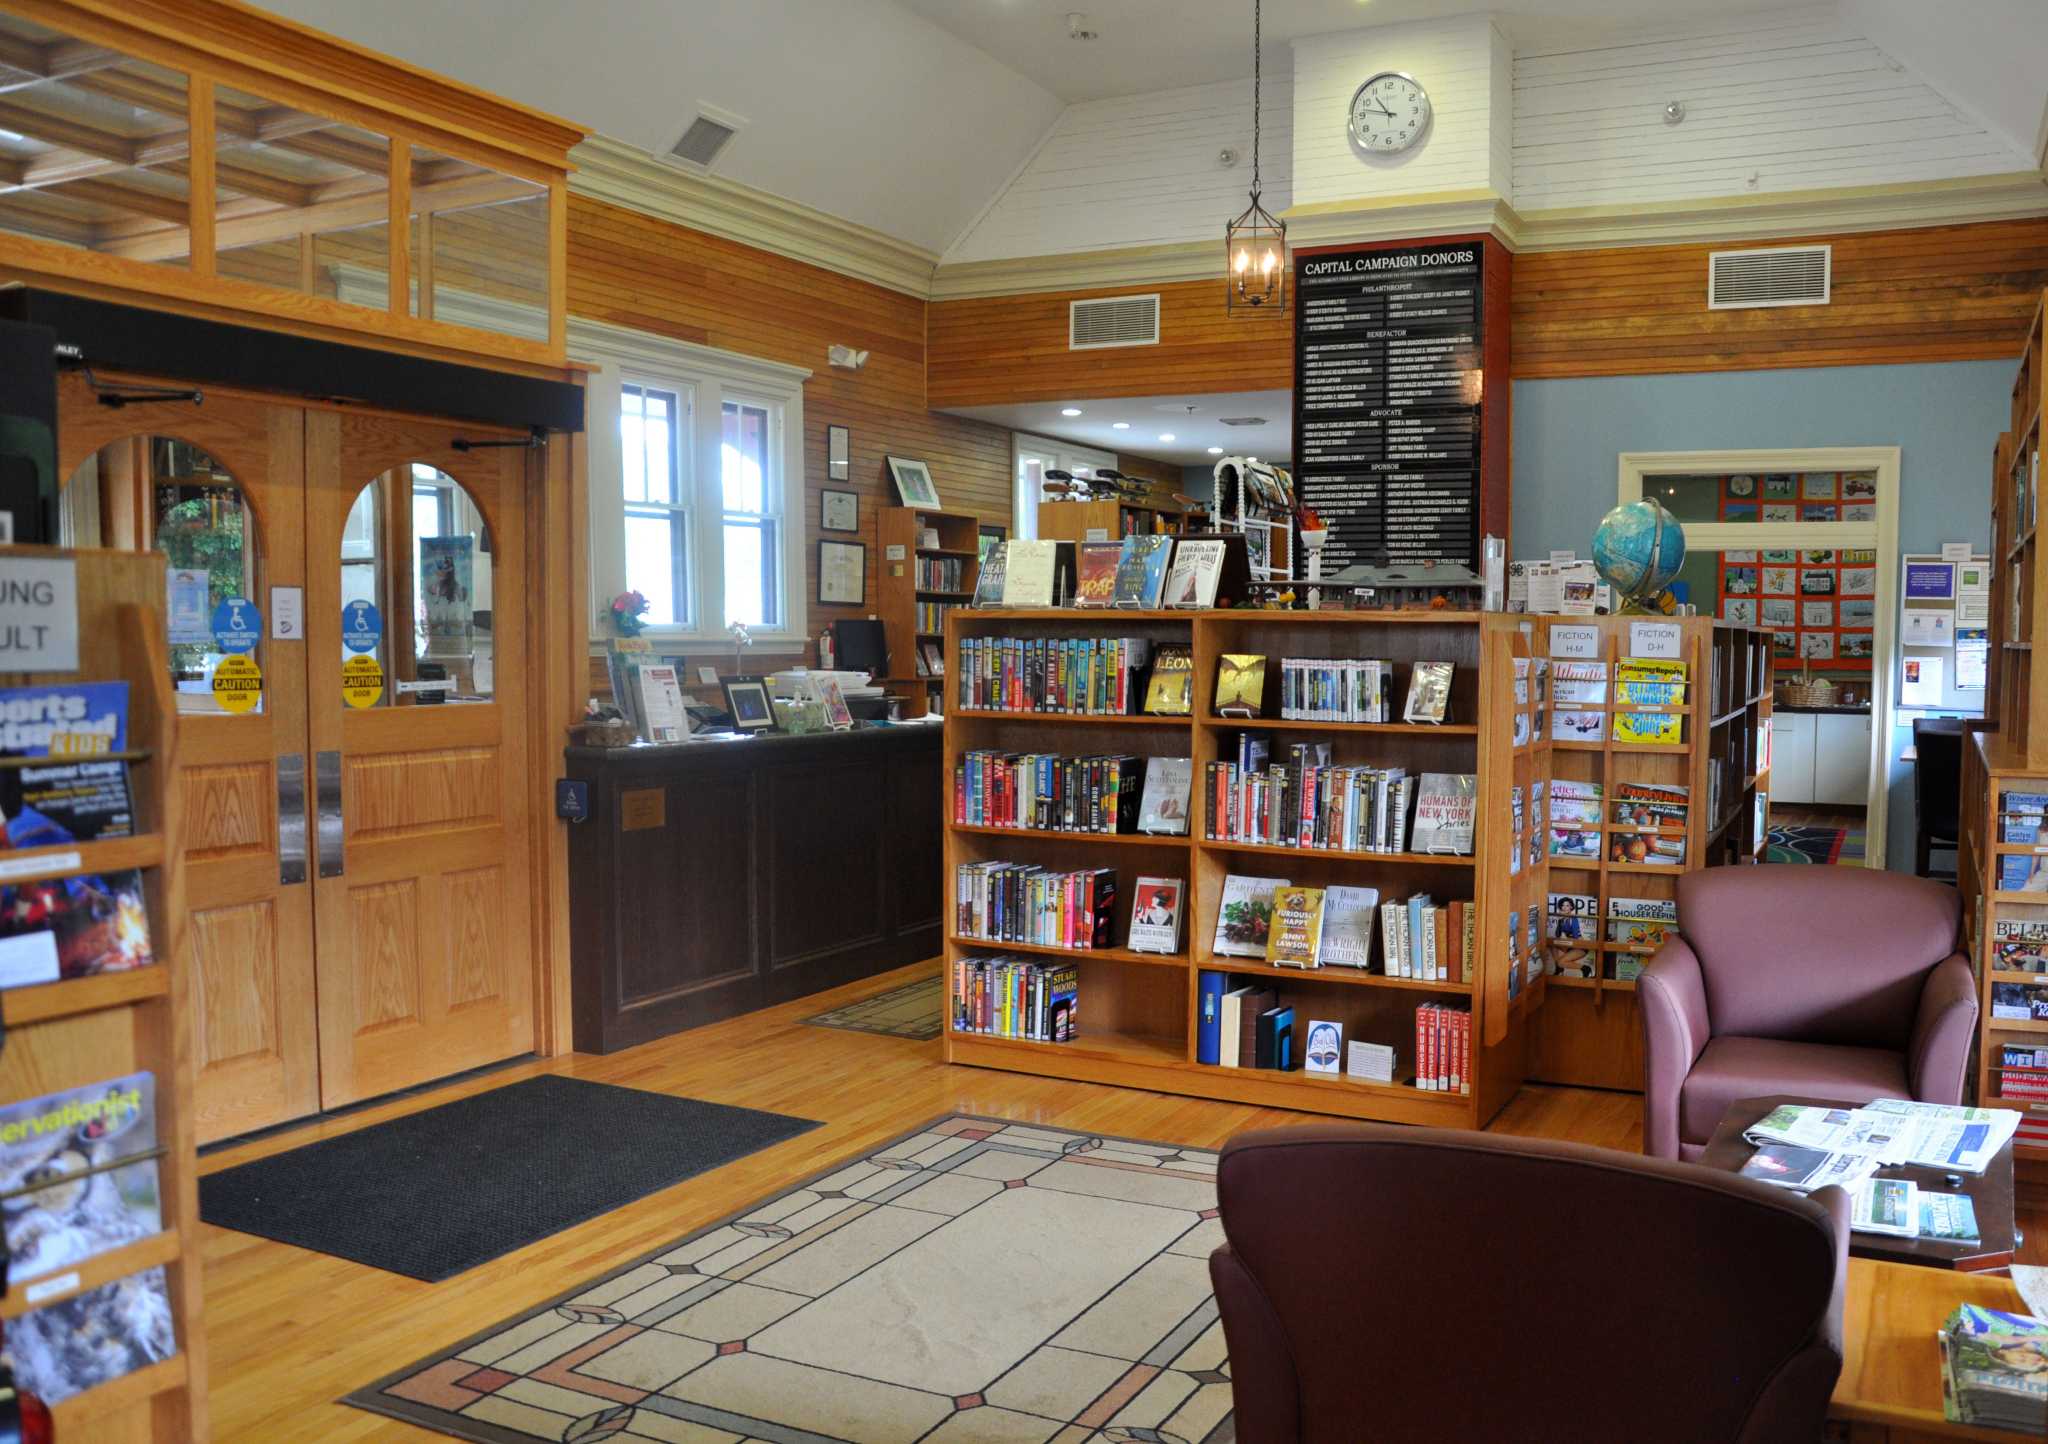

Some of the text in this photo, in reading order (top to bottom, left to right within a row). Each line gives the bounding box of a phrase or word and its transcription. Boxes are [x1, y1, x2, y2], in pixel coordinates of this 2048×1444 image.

[1305, 250, 1474, 275] CAPITAL CAMPAIGN DONORS
[1362, 283, 1413, 293] PHILANTHROPIST
[1366, 330, 1407, 338] BENEFACTOR
[1370, 409, 1403, 417] ADVOCATE
[1370, 463, 1400, 471] SPONSOR
[984, 563, 1007, 574] HEAT
[1557, 632, 1593, 640] FICTION
[1638, 630, 1675, 638] FICTION
[1648, 643, 1664, 651] D-H
[214, 678, 260, 690] CAUTION
[343, 676, 381, 688] CAUTION
[53, 734, 110, 753] KIDS
[1552, 784, 1577, 794] etter
[1421, 796, 1473, 806] HUMANS OF
[1419, 808, 1472, 820] NEW YORK
[1548, 897, 1596, 916] HPE
[1637, 903, 1664, 912] GOOD
[1278, 910, 1316, 919] FURIOUSLY
[1426, 912, 1434, 924] THE
[1618, 910, 1676, 920] HOUSEKEEPIN
[1283, 918, 1309, 927] HAPPY
[1281, 933, 1306, 941] JENNY
[1276, 940, 1309, 948] LAWSON
[1, 1088, 142, 1144] ervationist
